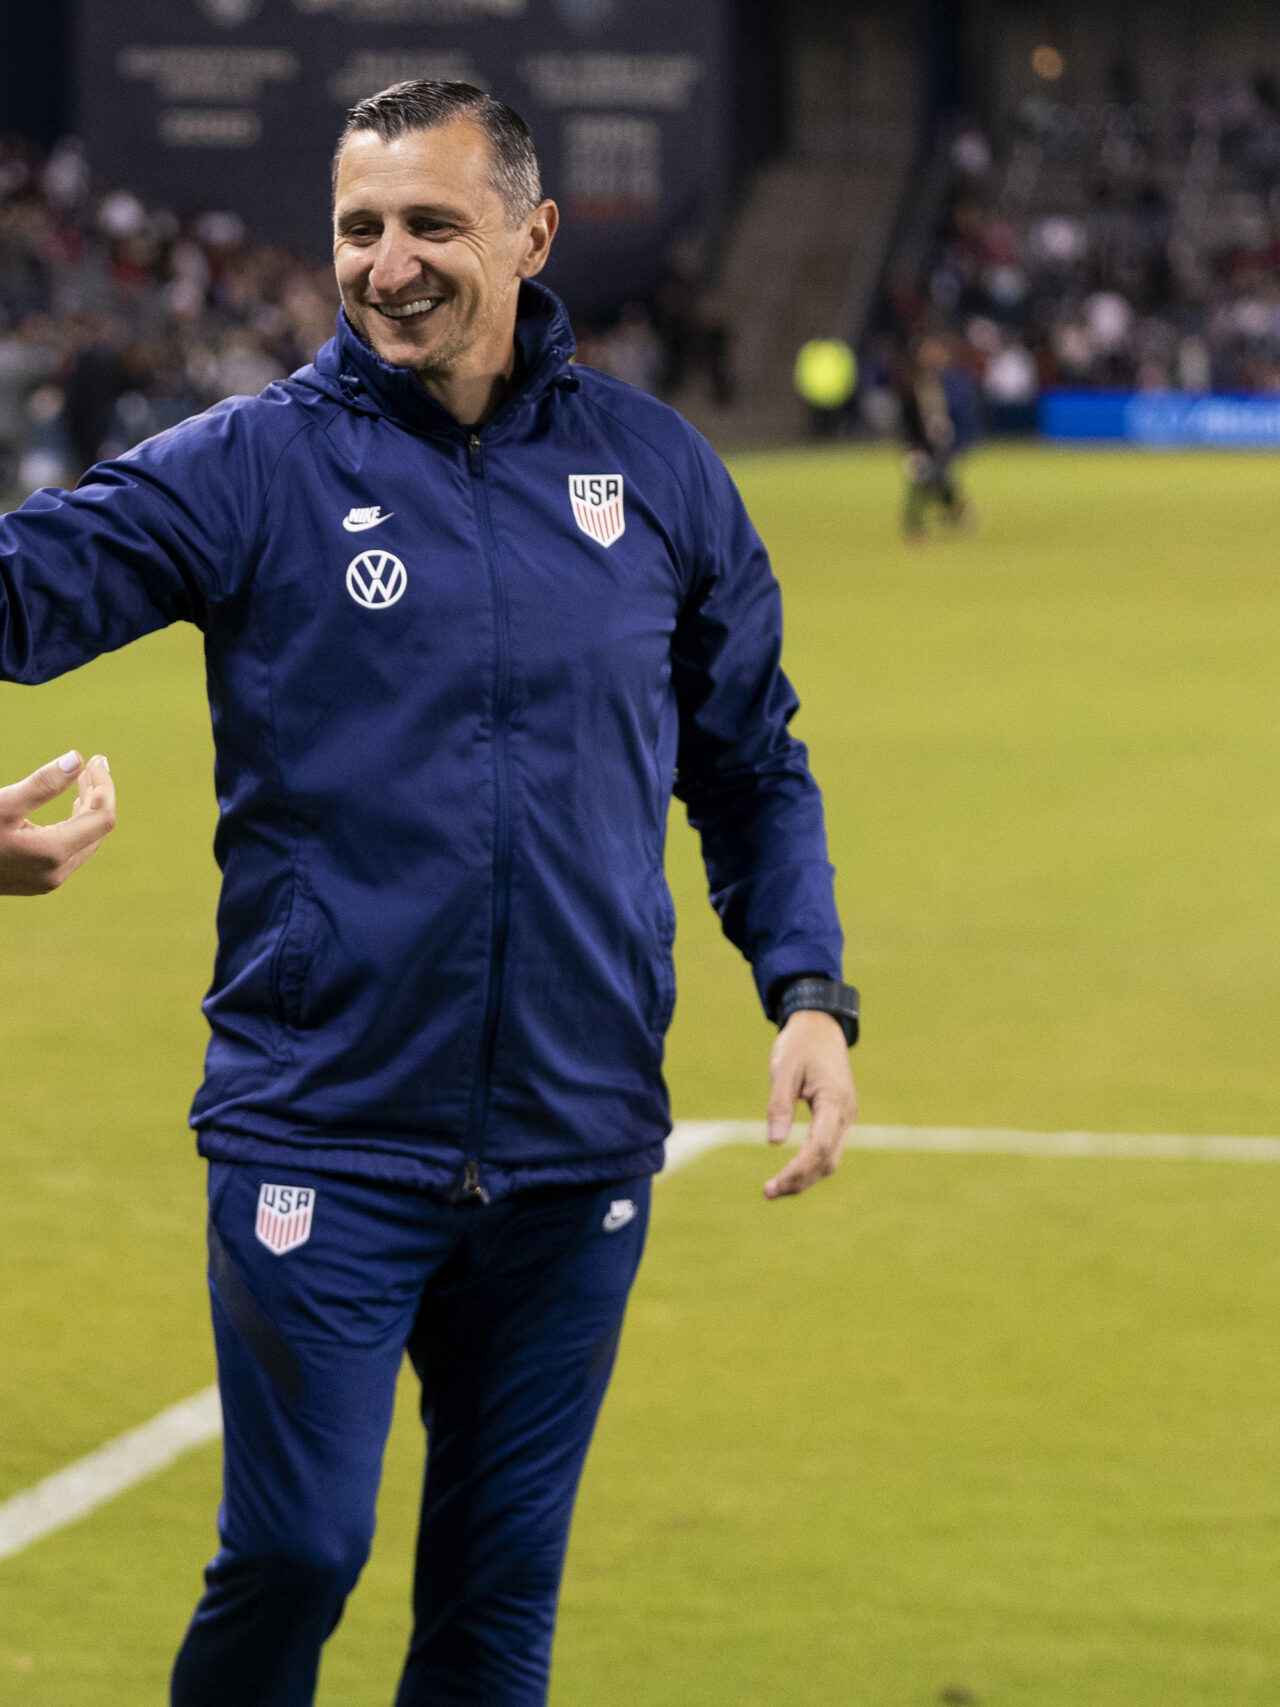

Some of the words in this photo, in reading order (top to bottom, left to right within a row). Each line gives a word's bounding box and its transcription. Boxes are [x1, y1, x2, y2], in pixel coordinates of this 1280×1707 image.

[573, 479, 619, 506] USA
[348, 505, 382, 524] NIKE
[350, 552, 403, 606] VW
[263, 1186, 311, 1214] USA
